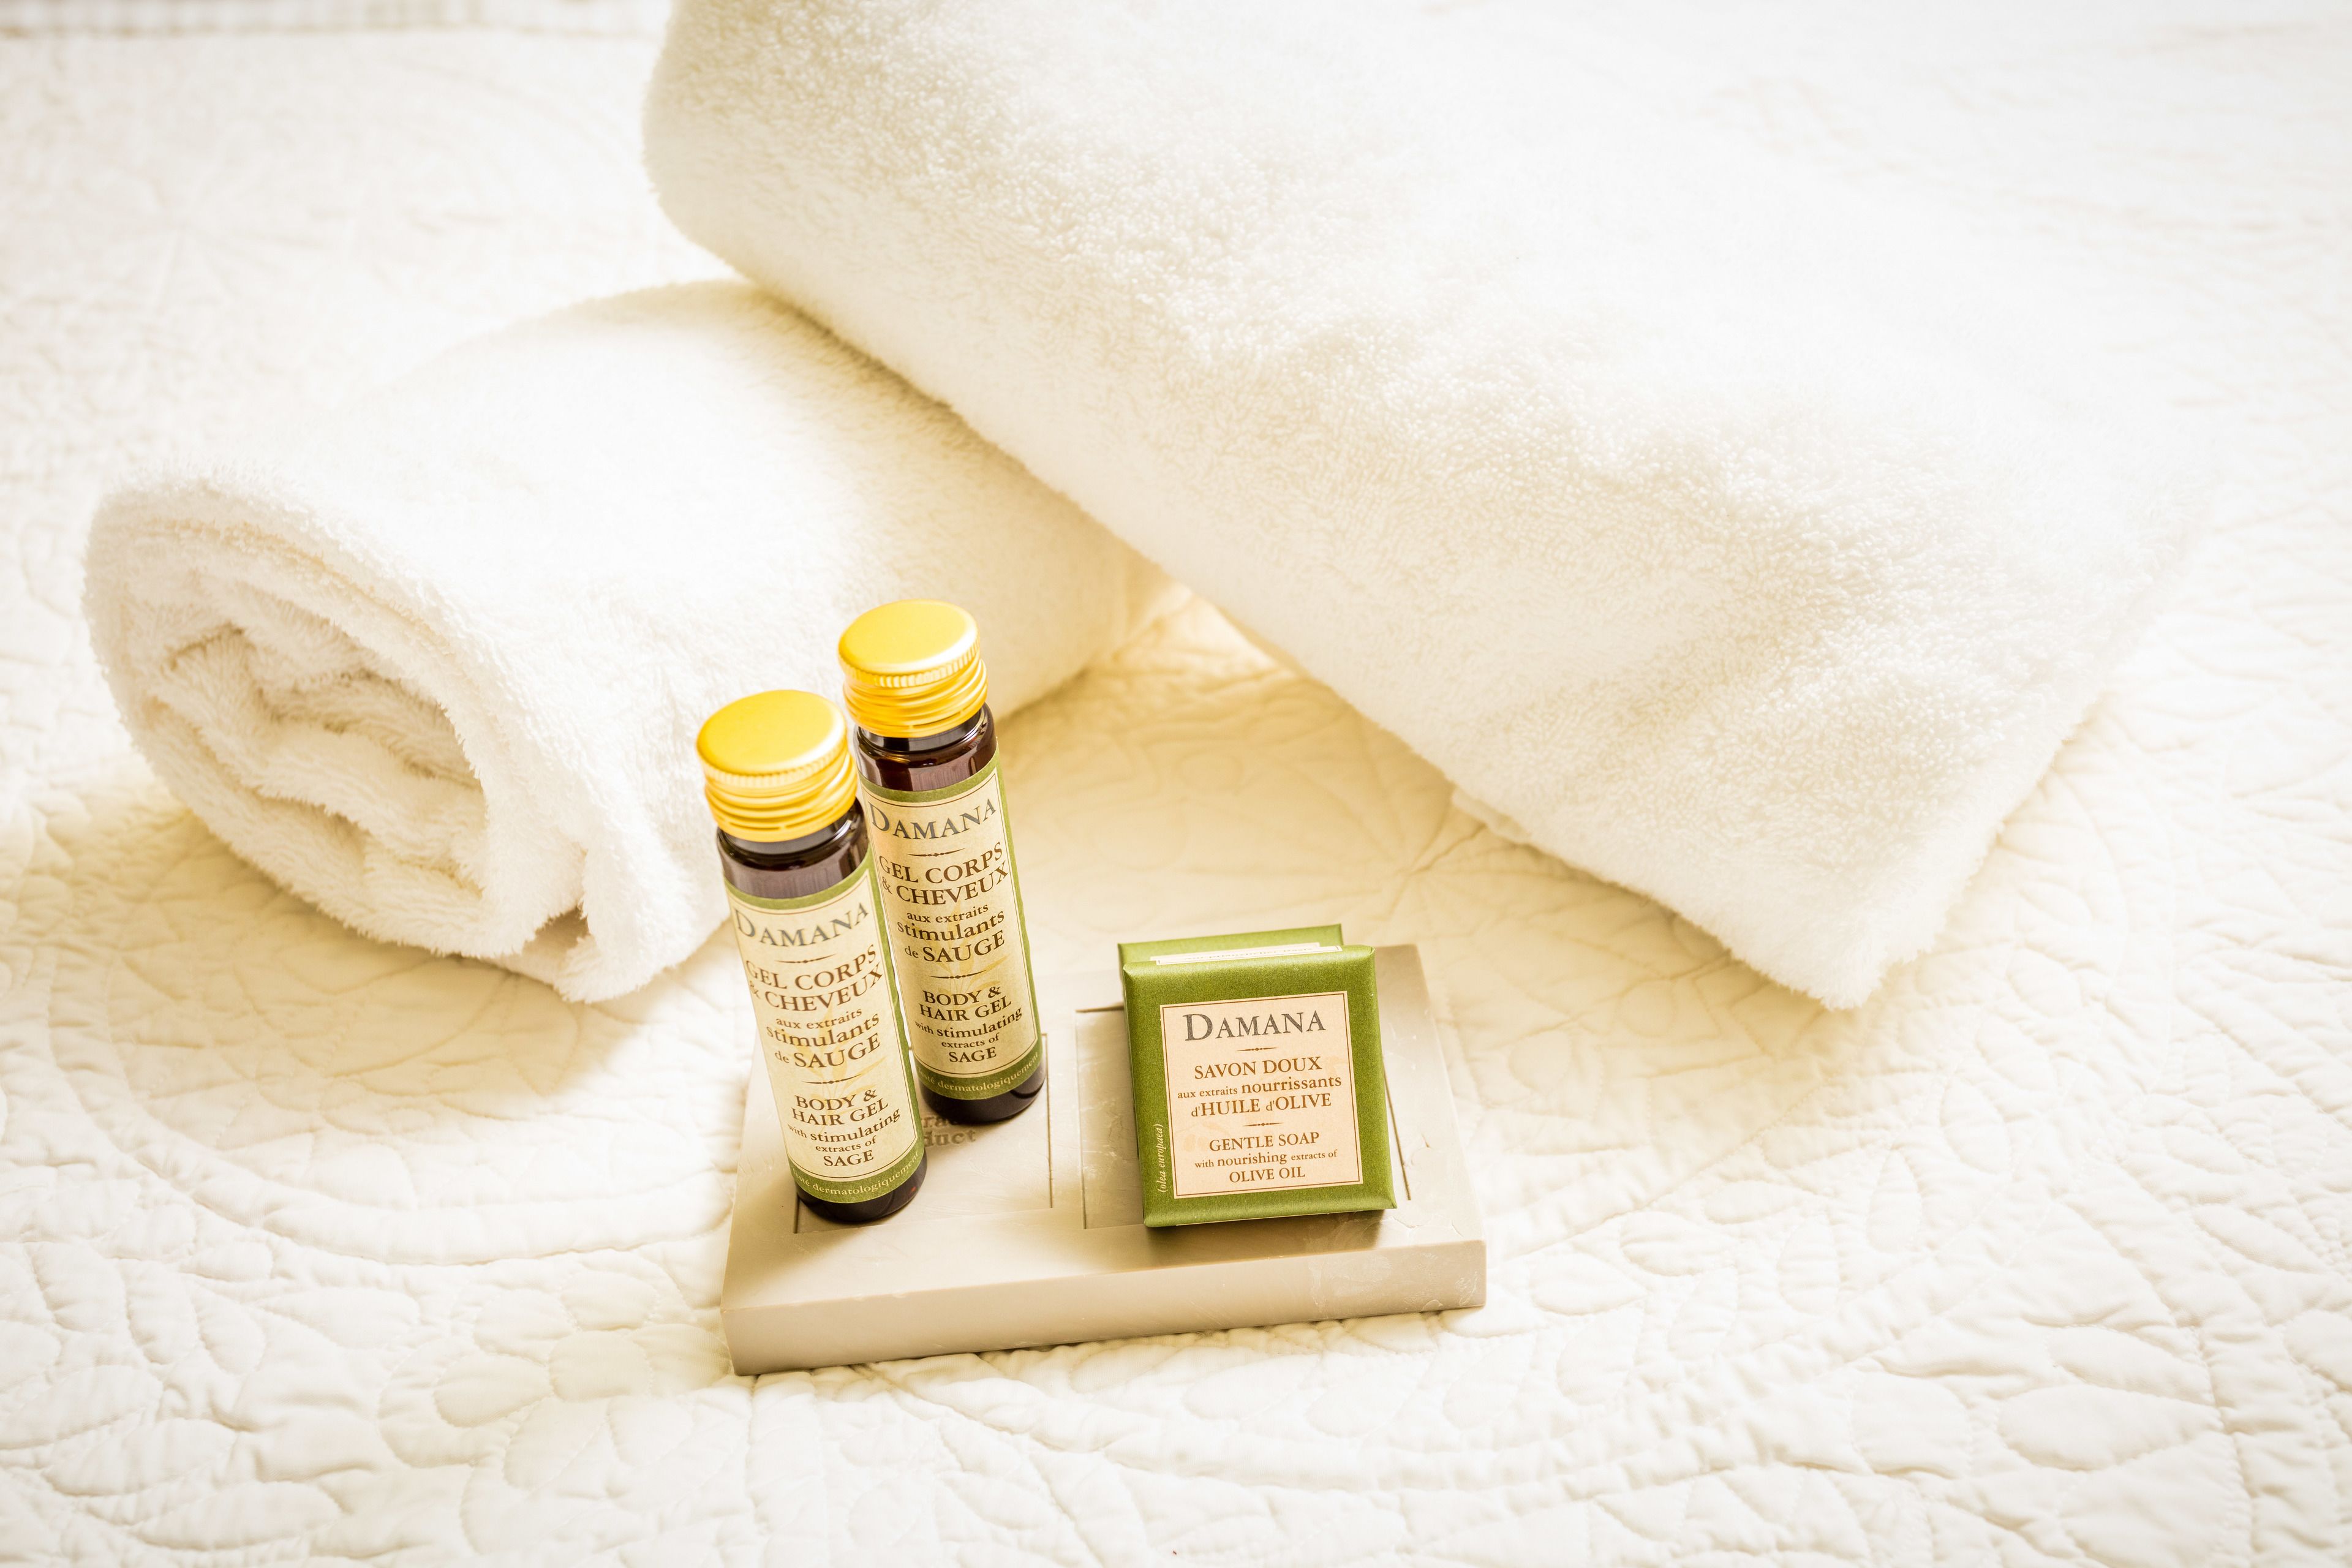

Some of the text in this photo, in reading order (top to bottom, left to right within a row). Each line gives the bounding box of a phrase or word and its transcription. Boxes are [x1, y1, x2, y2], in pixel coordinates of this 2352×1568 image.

[869, 799, 997, 839] DAMANA
[879, 842, 1002, 883] GEL CORPS
[882, 860, 1009, 905] & CHEVEUX
[897, 910, 1005, 941] stimulants
[907, 905, 989, 923] aux extraits
[905, 930, 1005, 962] de SAUGE
[746, 944, 876, 990] GEL CORPS
[765, 962, 883, 1011] CHEVEUX
[922, 986, 1002, 1006] BODY &
[776, 1009, 862, 1029] aux extraits
[919, 995, 1012, 1021] HAIR GEL
[766, 1014, 880, 1047] stimulants
[914, 1007, 1022, 1038] with stimulating
[1183, 1011, 1326, 1041] DAMANA
[775, 1033, 880, 1068] de SAUGE
[989, 1033, 1000, 1043] of
[949, 1047, 997, 1063] SAGE
[1195, 1056, 1322, 1079] SAVON DOUX
[938, 1052, 1038, 1091] dermatologiquement
[1199, 1086, 1237, 1096] extraits
[1242, 1076, 1341, 1094] nourrissants
[791, 1098, 888, 1126] HAIR GEL
[794, 1089, 878, 1110] BODY &
[1191, 1093, 1332, 1117] d'HUILE d'OLIVE
[788, 1124, 807, 1139] with
[811, 1108, 900, 1142] stimulating
[865, 1136, 877, 1147] of
[924, 1129, 976, 1147] duct
[1209, 1132, 1320, 1152] GENTLE SOAP
[824, 1150, 874, 1166] SAGE
[1194, 1149, 1338, 1168] with nourishing extracts of
[813, 1152, 919, 1196] dermatologiquement
[1156, 1171, 1169, 1193] (olea
[1229, 1167, 1305, 1183] OLIVE OIL
